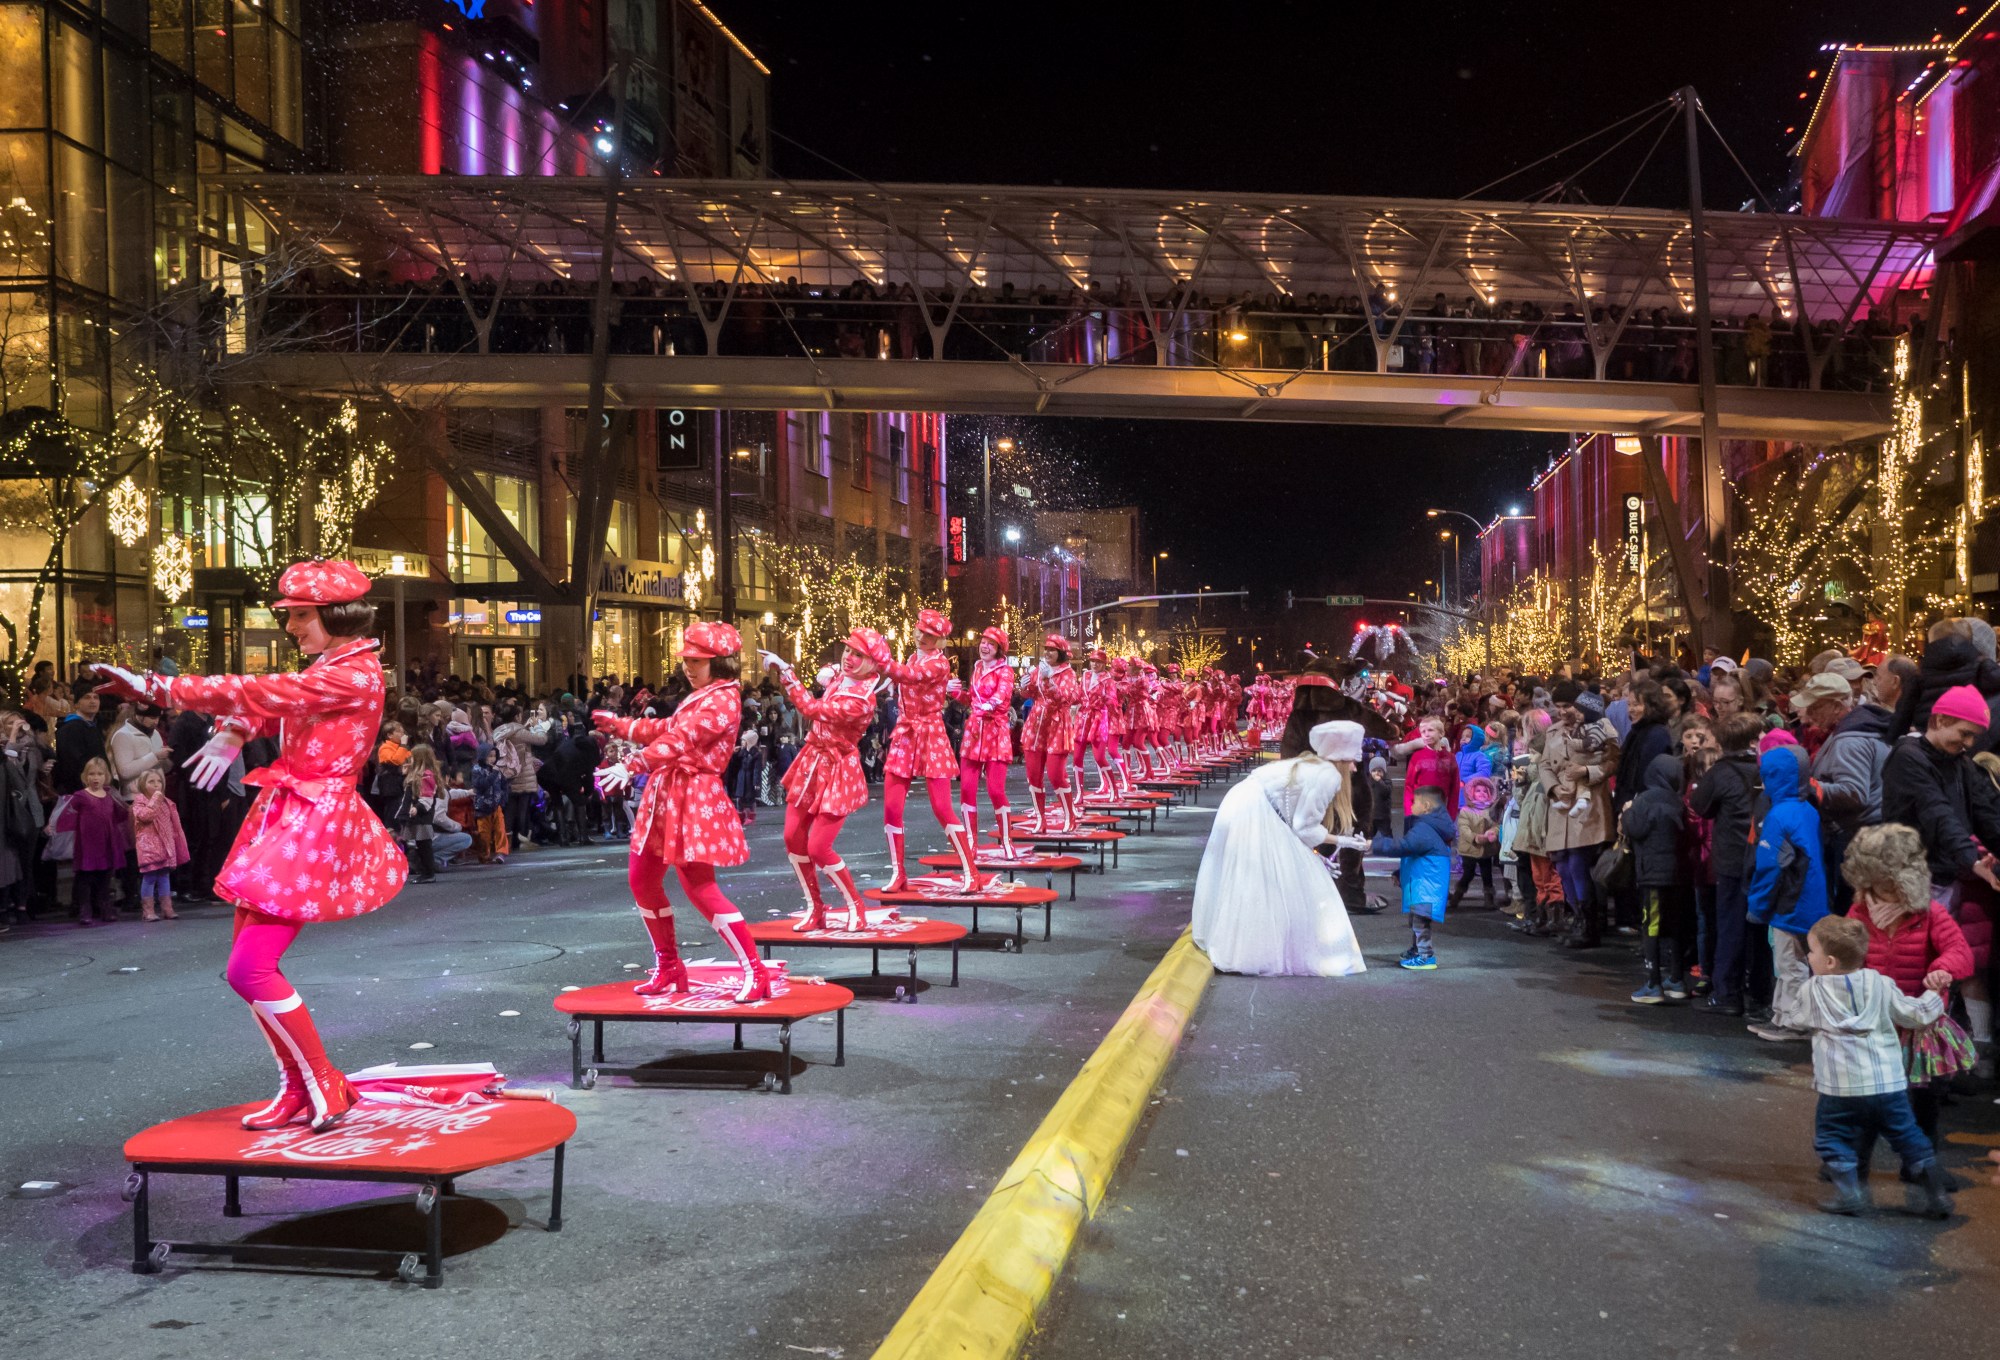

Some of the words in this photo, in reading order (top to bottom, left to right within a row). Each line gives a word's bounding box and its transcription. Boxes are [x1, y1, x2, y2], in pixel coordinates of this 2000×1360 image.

[1629, 512, 1638, 534] BLUE
[510, 612, 527, 621] The
[243, 1124, 394, 1160] Lane
